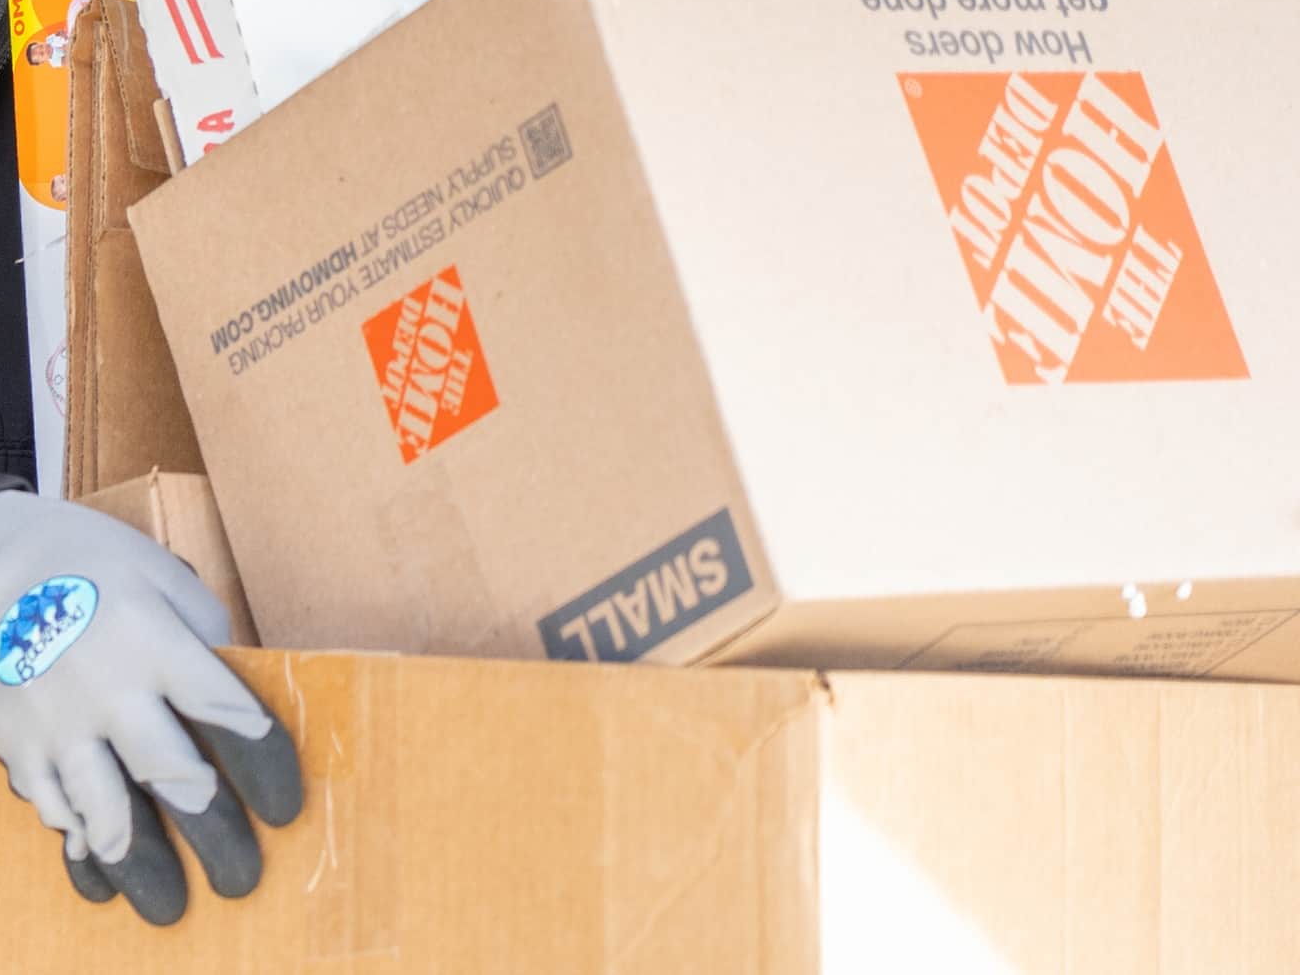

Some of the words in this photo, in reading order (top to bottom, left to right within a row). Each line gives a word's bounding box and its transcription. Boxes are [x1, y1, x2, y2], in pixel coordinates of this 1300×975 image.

[904, 29, 1004, 64] doers
[1015, 29, 1093, 64] How
[447, 135, 518, 198] SUPPLY
[449, 165, 526, 234] QUICKLY
[950, 72, 1059, 271] DEPOT
[361, 222, 381, 257] AT
[381, 182, 445, 239] NEEDS
[988, 72, 1166, 384] HOME
[358, 217, 446, 290] ESTIMATE
[1102, 222, 1184, 352] THE
[210, 241, 359, 355] HDMOVING.COM
[305, 277, 360, 324] YOUR
[228, 308, 307, 375] PACKING
[381, 296, 425, 409] DEPOT
[398, 277, 465, 454] HOME
[442, 348, 475, 418] THE
[558, 536, 729, 663] SMALL
